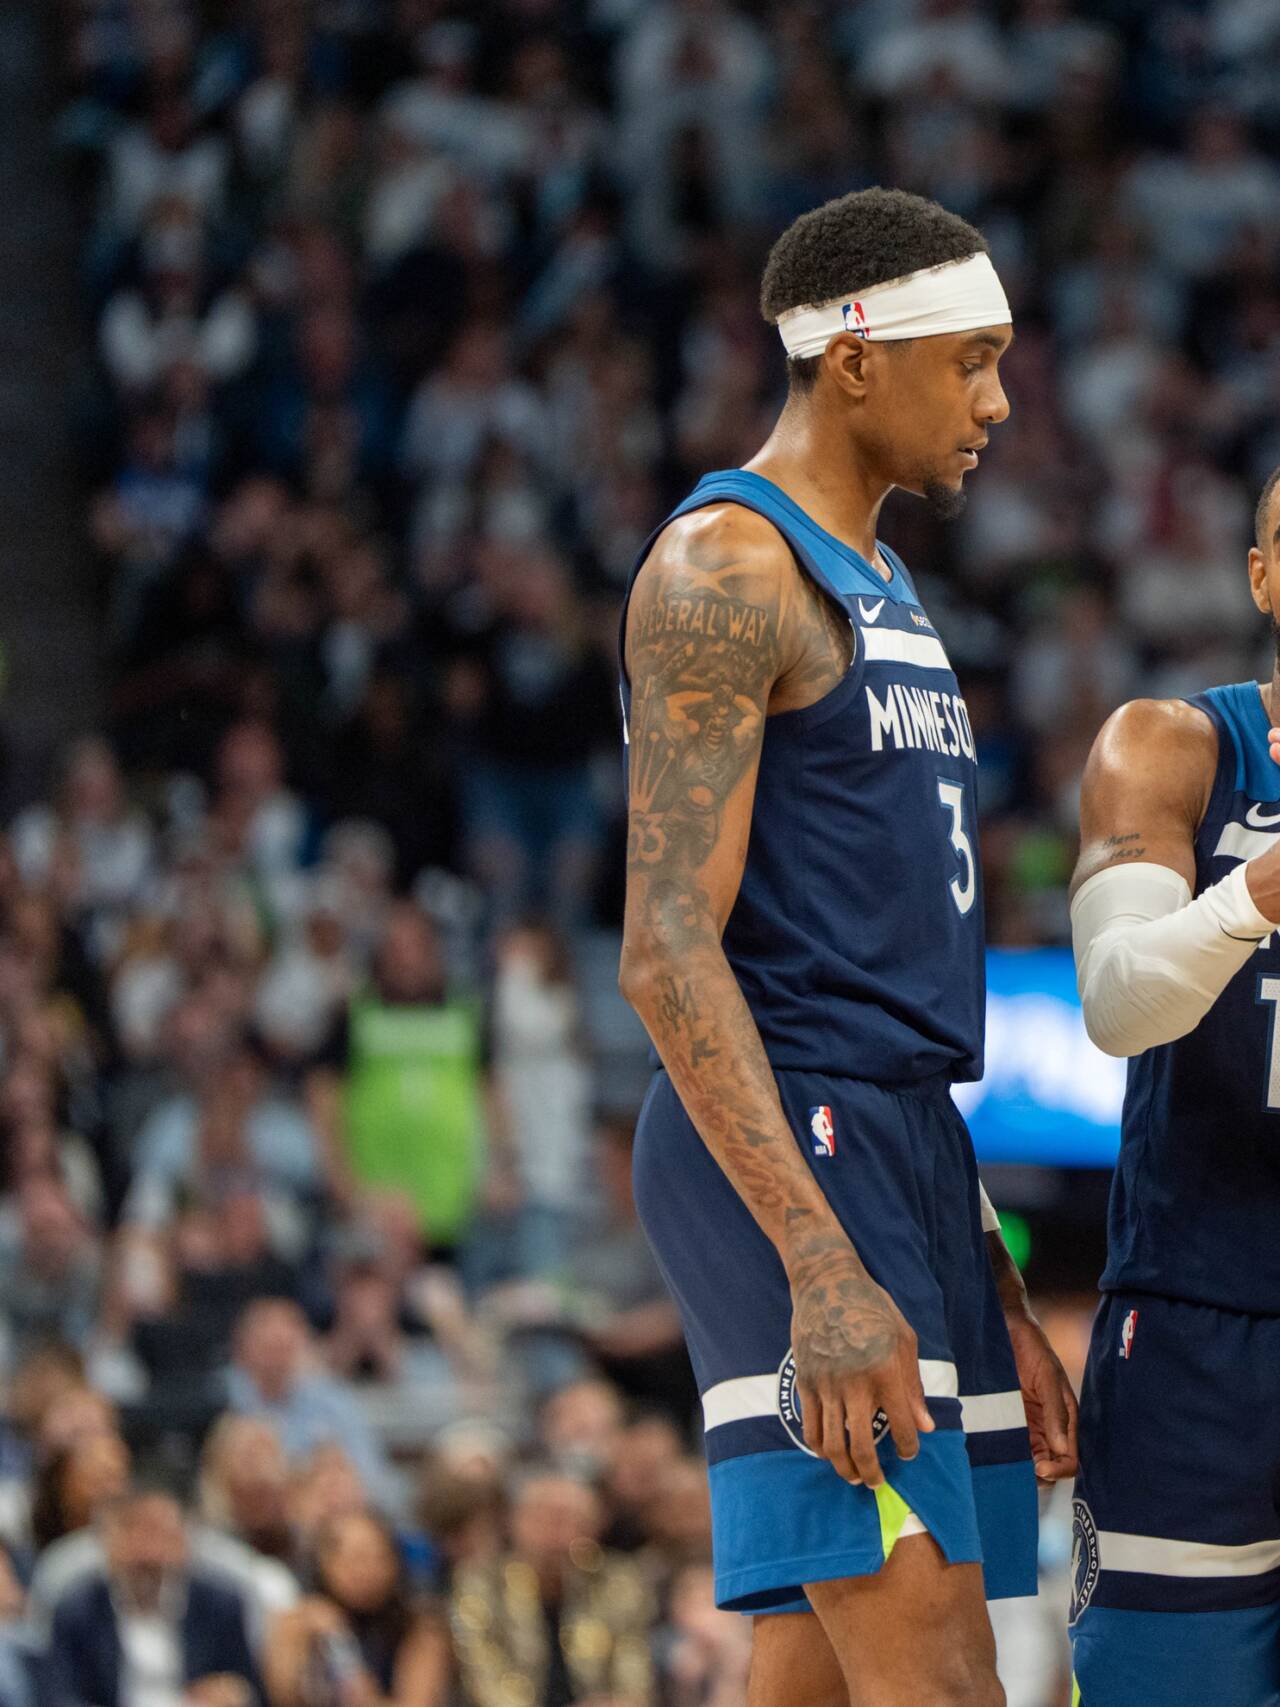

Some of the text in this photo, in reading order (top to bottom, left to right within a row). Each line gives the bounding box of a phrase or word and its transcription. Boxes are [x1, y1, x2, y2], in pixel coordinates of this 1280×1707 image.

[728, 605, 769, 647] WAY
[865, 684, 978, 766] MINNESO
[936, 777, 976, 917] 3
[781, 1358, 797, 1421] MINNE
[1076, 1505, 1099, 1606] TIMBERWOLVES
